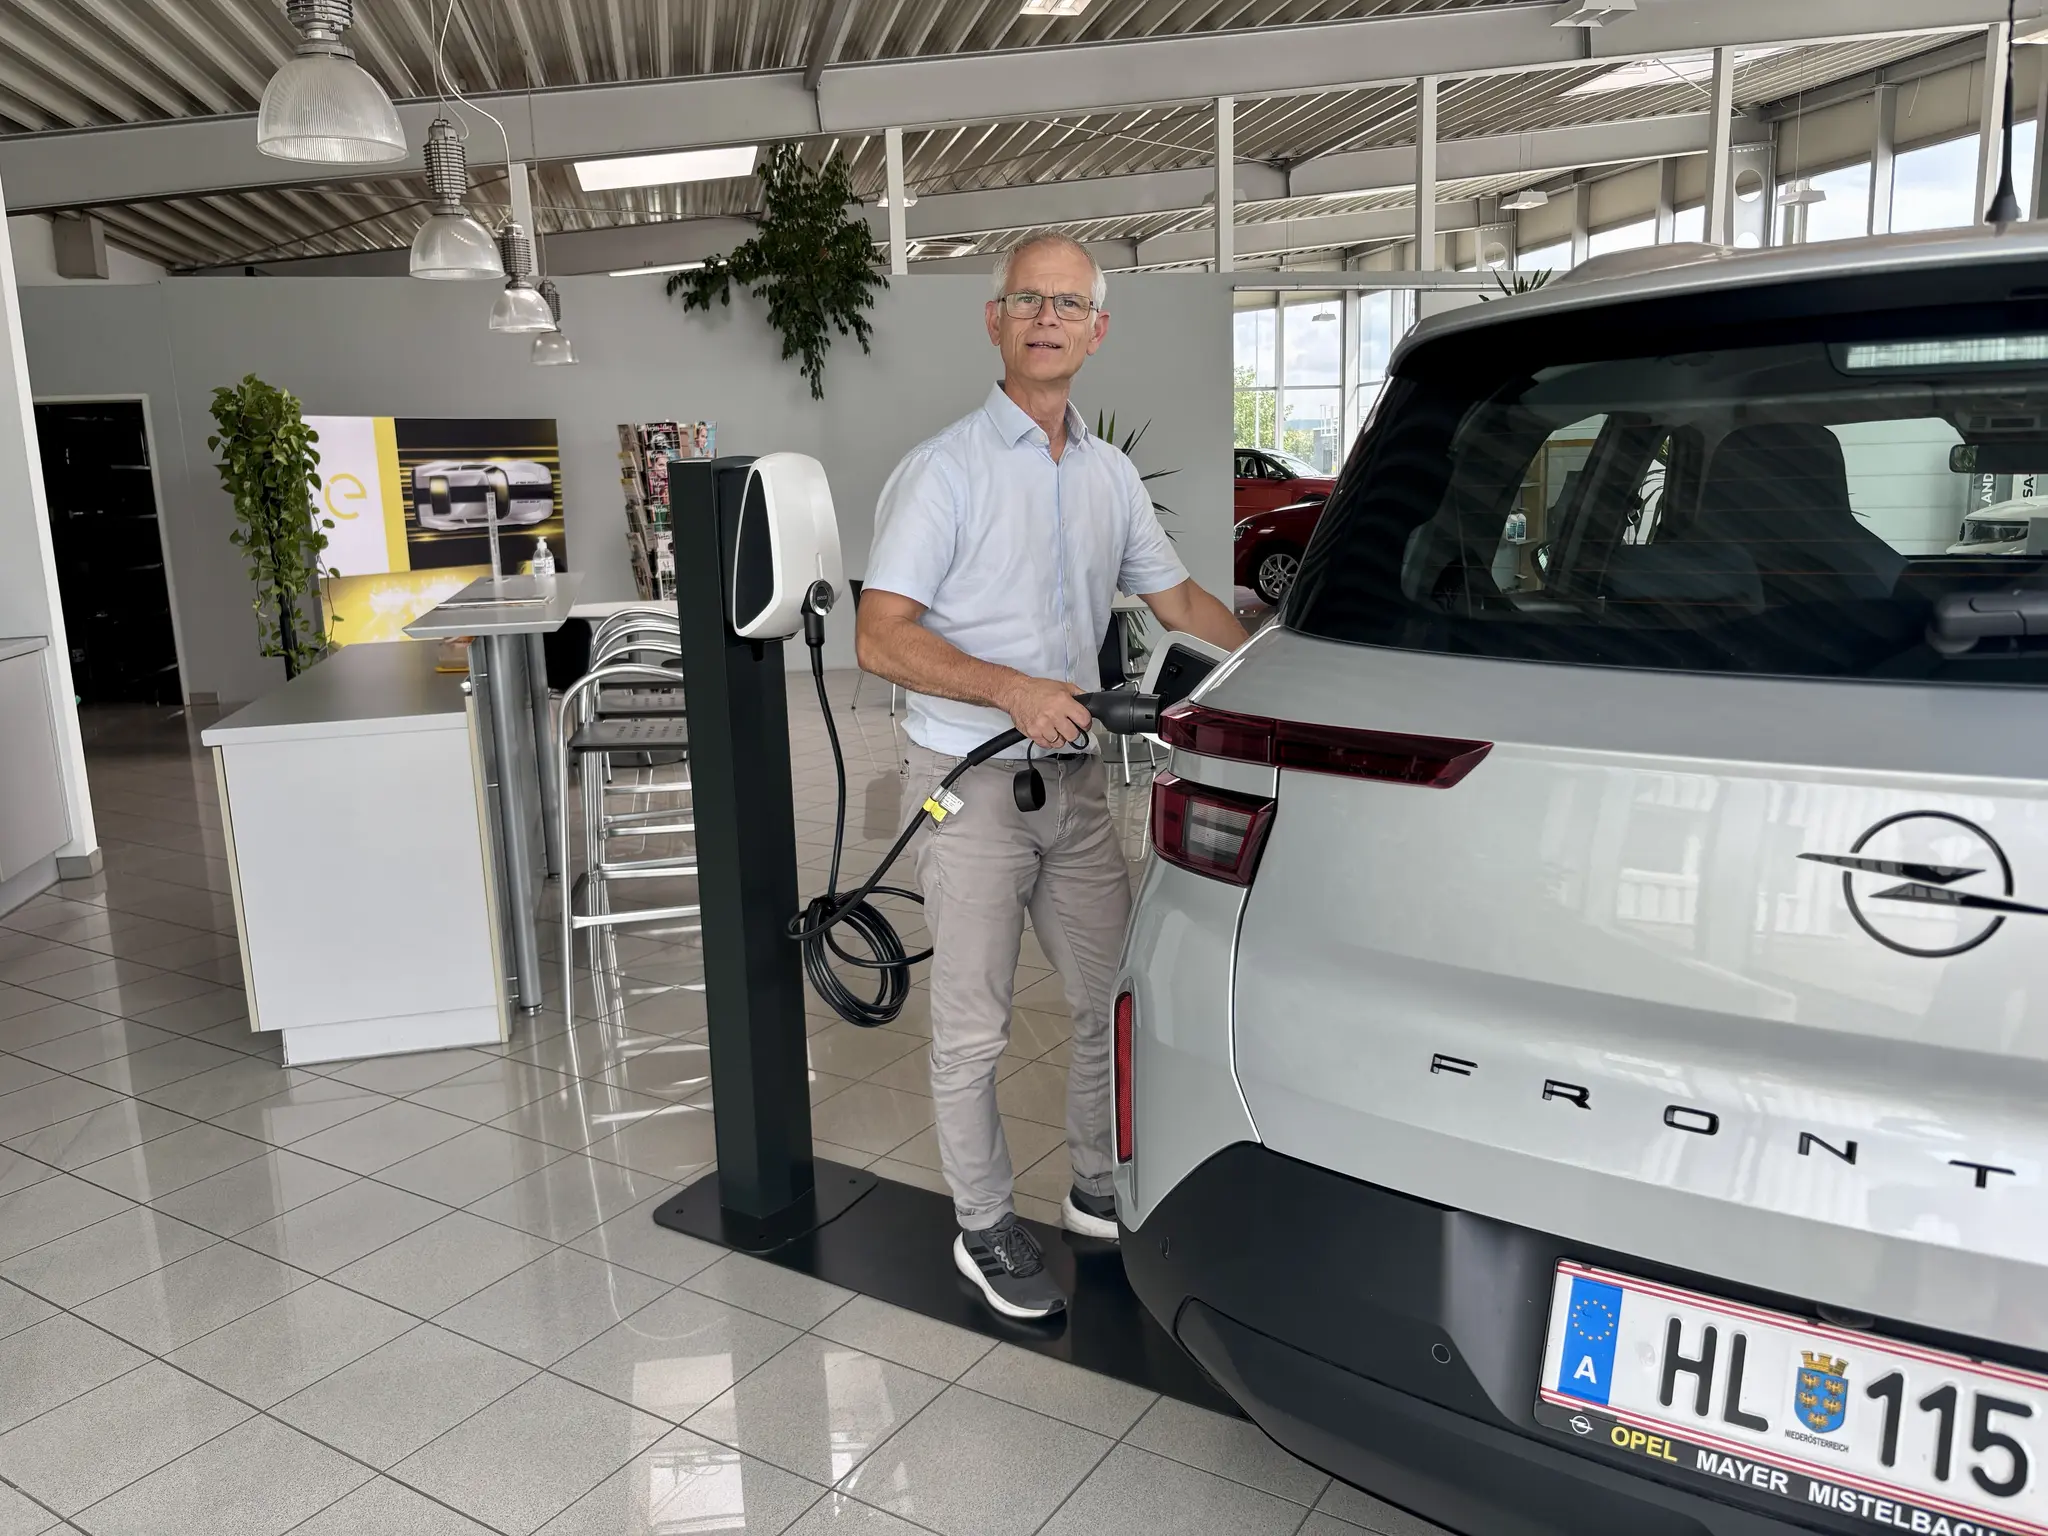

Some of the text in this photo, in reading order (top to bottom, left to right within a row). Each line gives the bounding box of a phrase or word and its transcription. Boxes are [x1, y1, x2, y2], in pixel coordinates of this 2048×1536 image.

[1981, 474, 1993, 507] AND
[1572, 1354, 1598, 1385] A
[1658, 1315, 2034, 1498] HL 115
[1784, 1428, 1849, 1454] NIEDERÖSTERREICH
[1610, 1424, 1678, 1462] OPEL
[1696, 1449, 1789, 1495] MAYER
